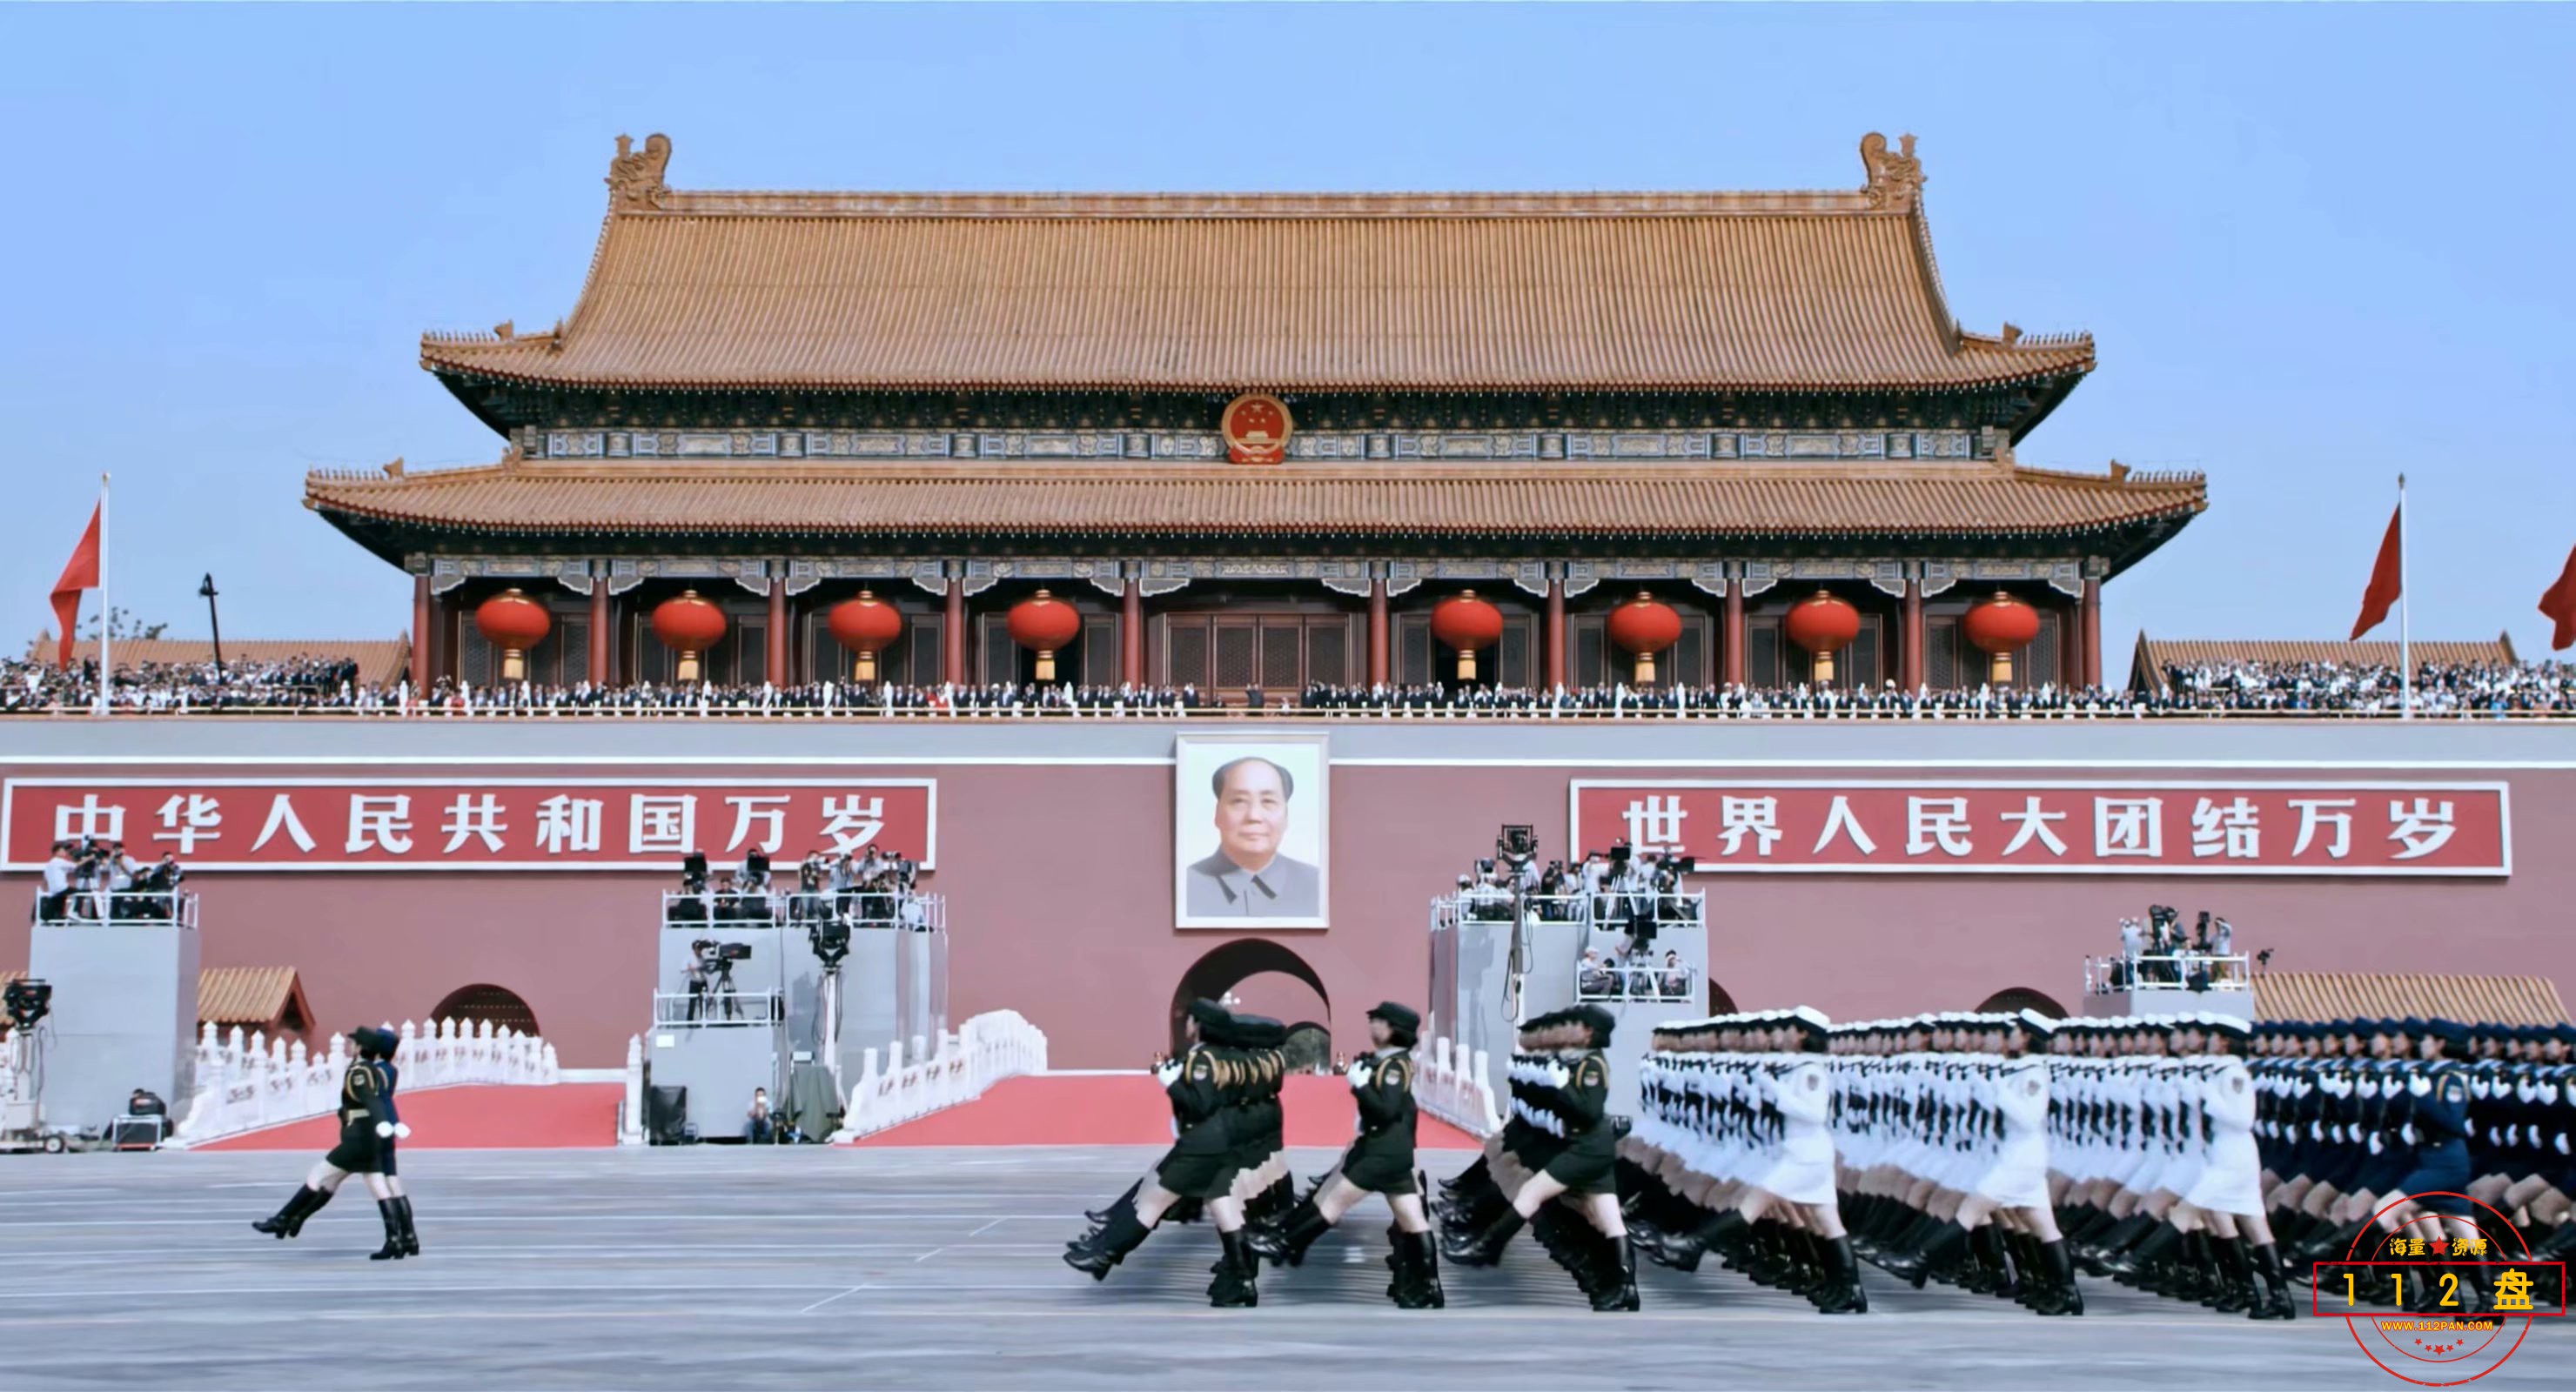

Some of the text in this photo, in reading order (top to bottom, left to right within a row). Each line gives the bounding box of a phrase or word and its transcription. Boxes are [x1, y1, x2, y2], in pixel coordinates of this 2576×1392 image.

[54, 793, 886, 855] 中华人民共和国万岁
[1622, 795, 2457, 860] 世界人民大团结万岁
